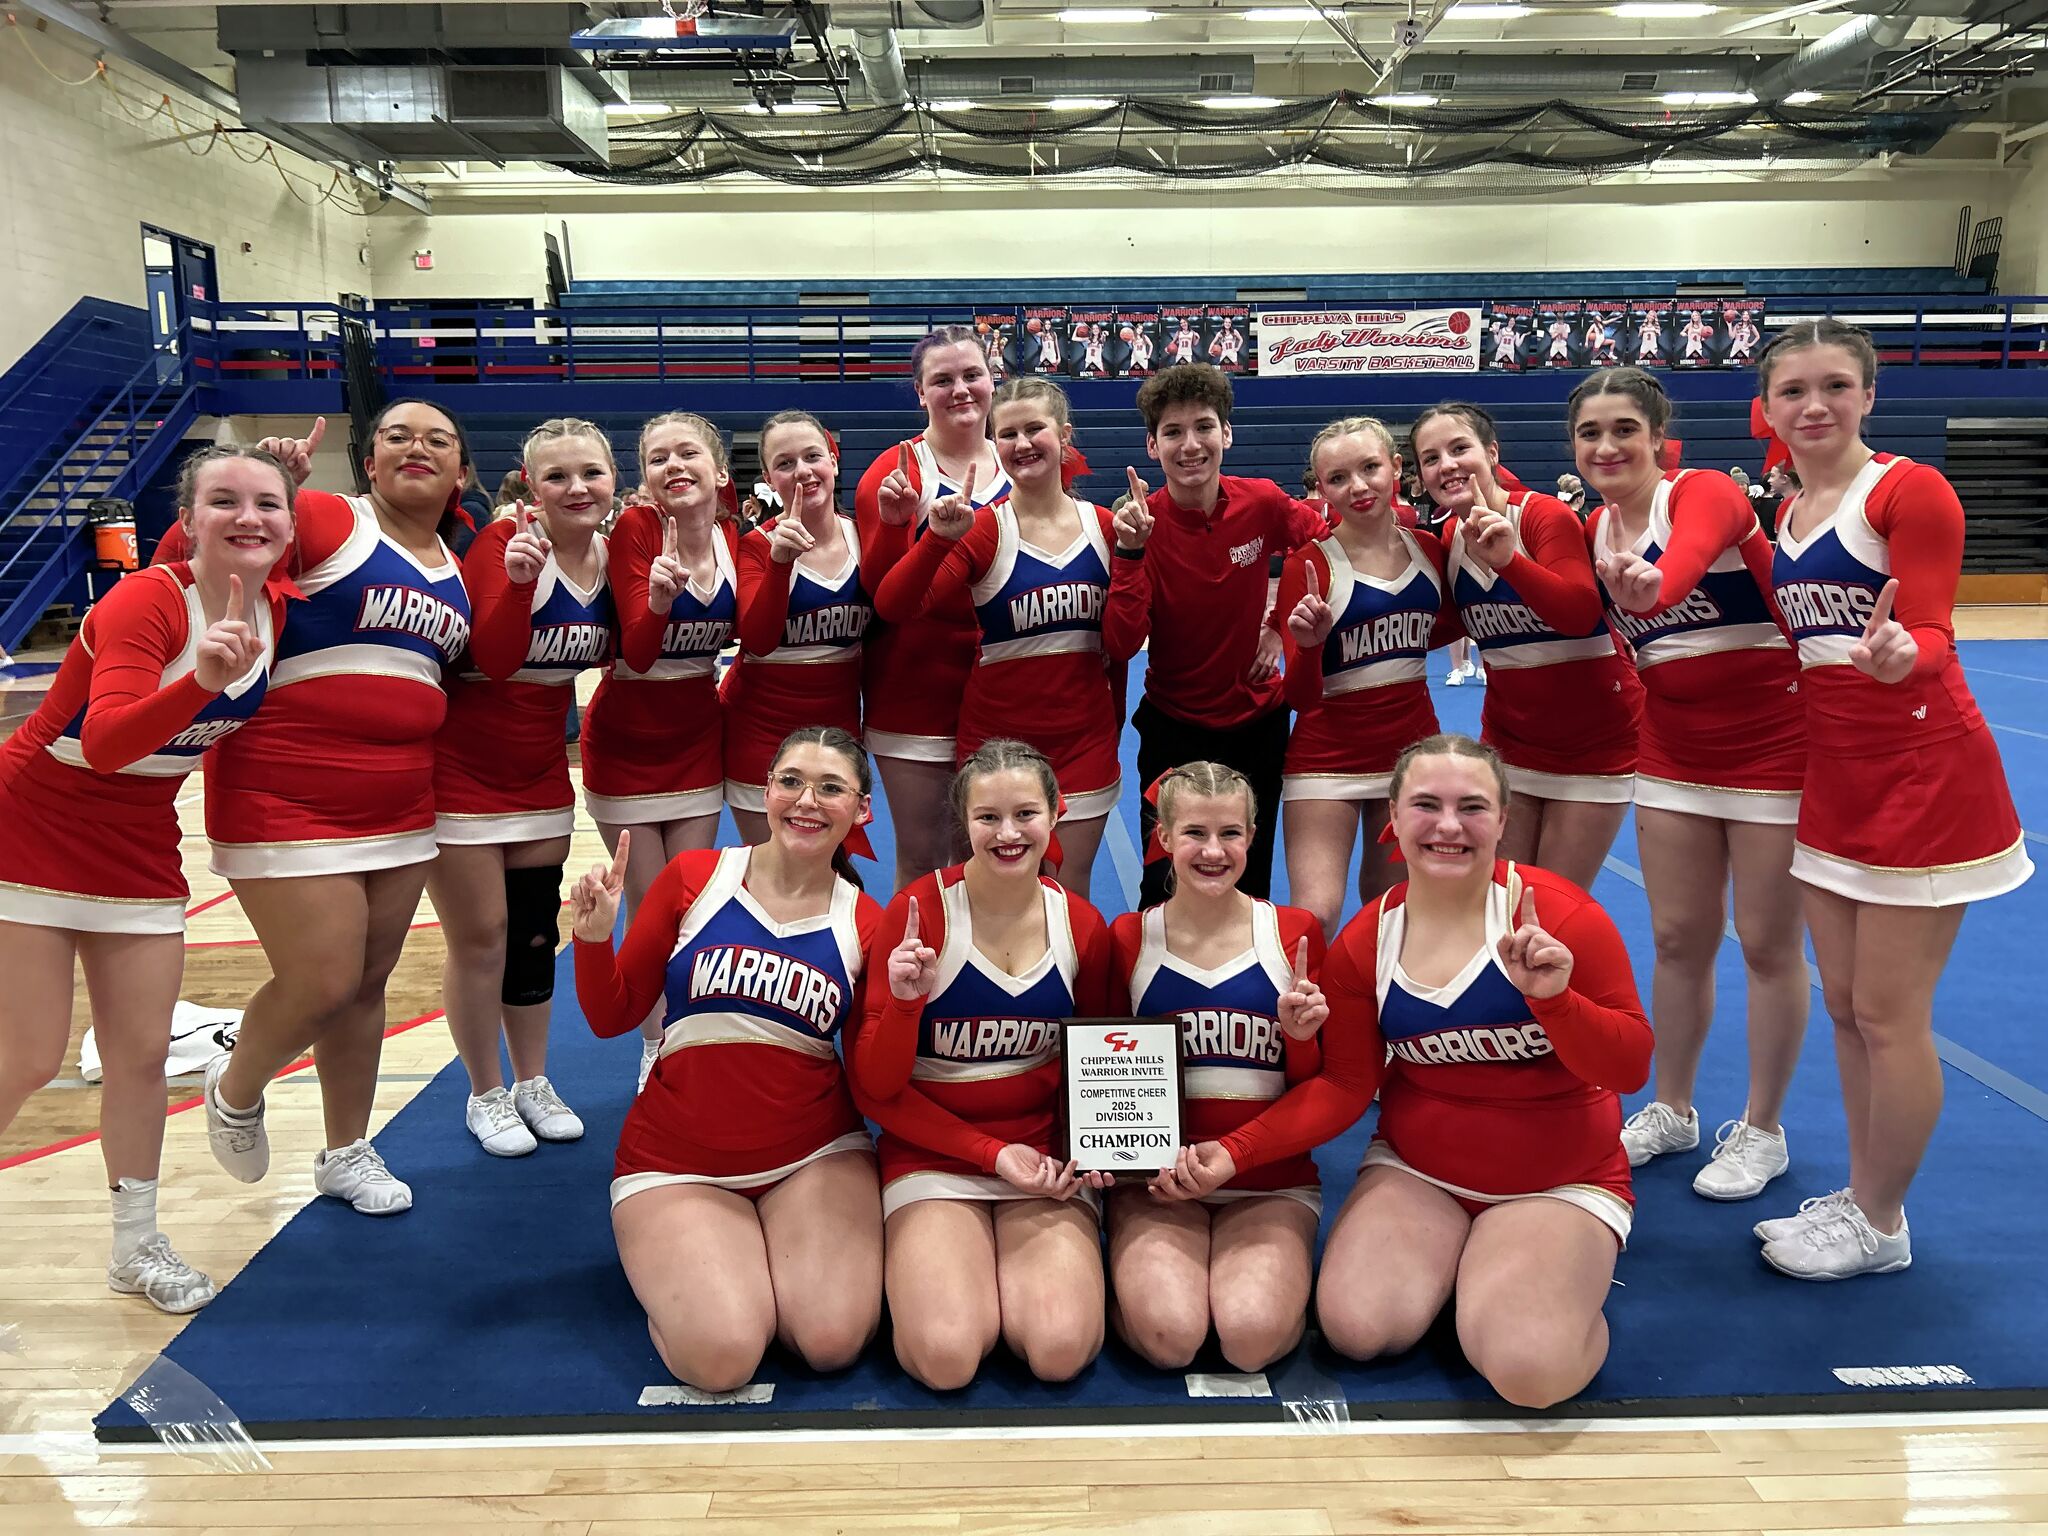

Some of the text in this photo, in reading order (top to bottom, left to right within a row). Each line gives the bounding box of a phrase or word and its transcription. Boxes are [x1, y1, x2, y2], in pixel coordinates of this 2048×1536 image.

[1492, 304, 1534, 317] WARRIORS
[1540, 303, 1581, 312] WARRIORS
[1585, 303, 1627, 312] WARRIORS
[1631, 301, 1673, 310] WARRIORS
[1676, 301, 1718, 310] WARRIORS
[1722, 301, 1764, 310] WARRIORS
[1025, 308, 1067, 318] WARRIORS
[1072, 312, 1113, 321] WARRIORS
[1162, 307, 1203, 316] WARRIORS
[1207, 307, 1249, 316] WARRIORS
[975, 315, 1016, 324] WARRIORS
[1117, 313, 1158, 322] WARRIORS
[1262, 312, 1406, 325] CHIPPEWA HILLS
[1269, 328, 1472, 364] Lady Warriors
[1295, 355, 1475, 372] VARSITY BASKETBALL
[1773, 583, 1877, 632] RRIORS
[358, 587, 471, 664] WARRIORS
[785, 605, 873, 644] WARRIOR
[661, 621, 732, 652] ARRIOR
[527, 625, 609, 663] WARRIO
[691, 947, 841, 1033] WARRIORS
[934, 1020, 1060, 1058] WARRIOR
[1103, 1031, 1139, 1052] CH
[1176, 1010, 1283, 1064] RRIORS
[1390, 1023, 1554, 1065] WARRIORS
[1080, 1055, 1164, 1066] CHIPPEWA HILLS
[1081, 1067, 1164, 1077] WARRIOR INVITE
[1080, 1088, 1167, 1098] COMPETITIVE CHEER
[1111, 1101, 1136, 1111] 2025
[1095, 1111, 1153, 1122] DIVISION 3
[1079, 1133, 1171, 1149] CHAMPION
